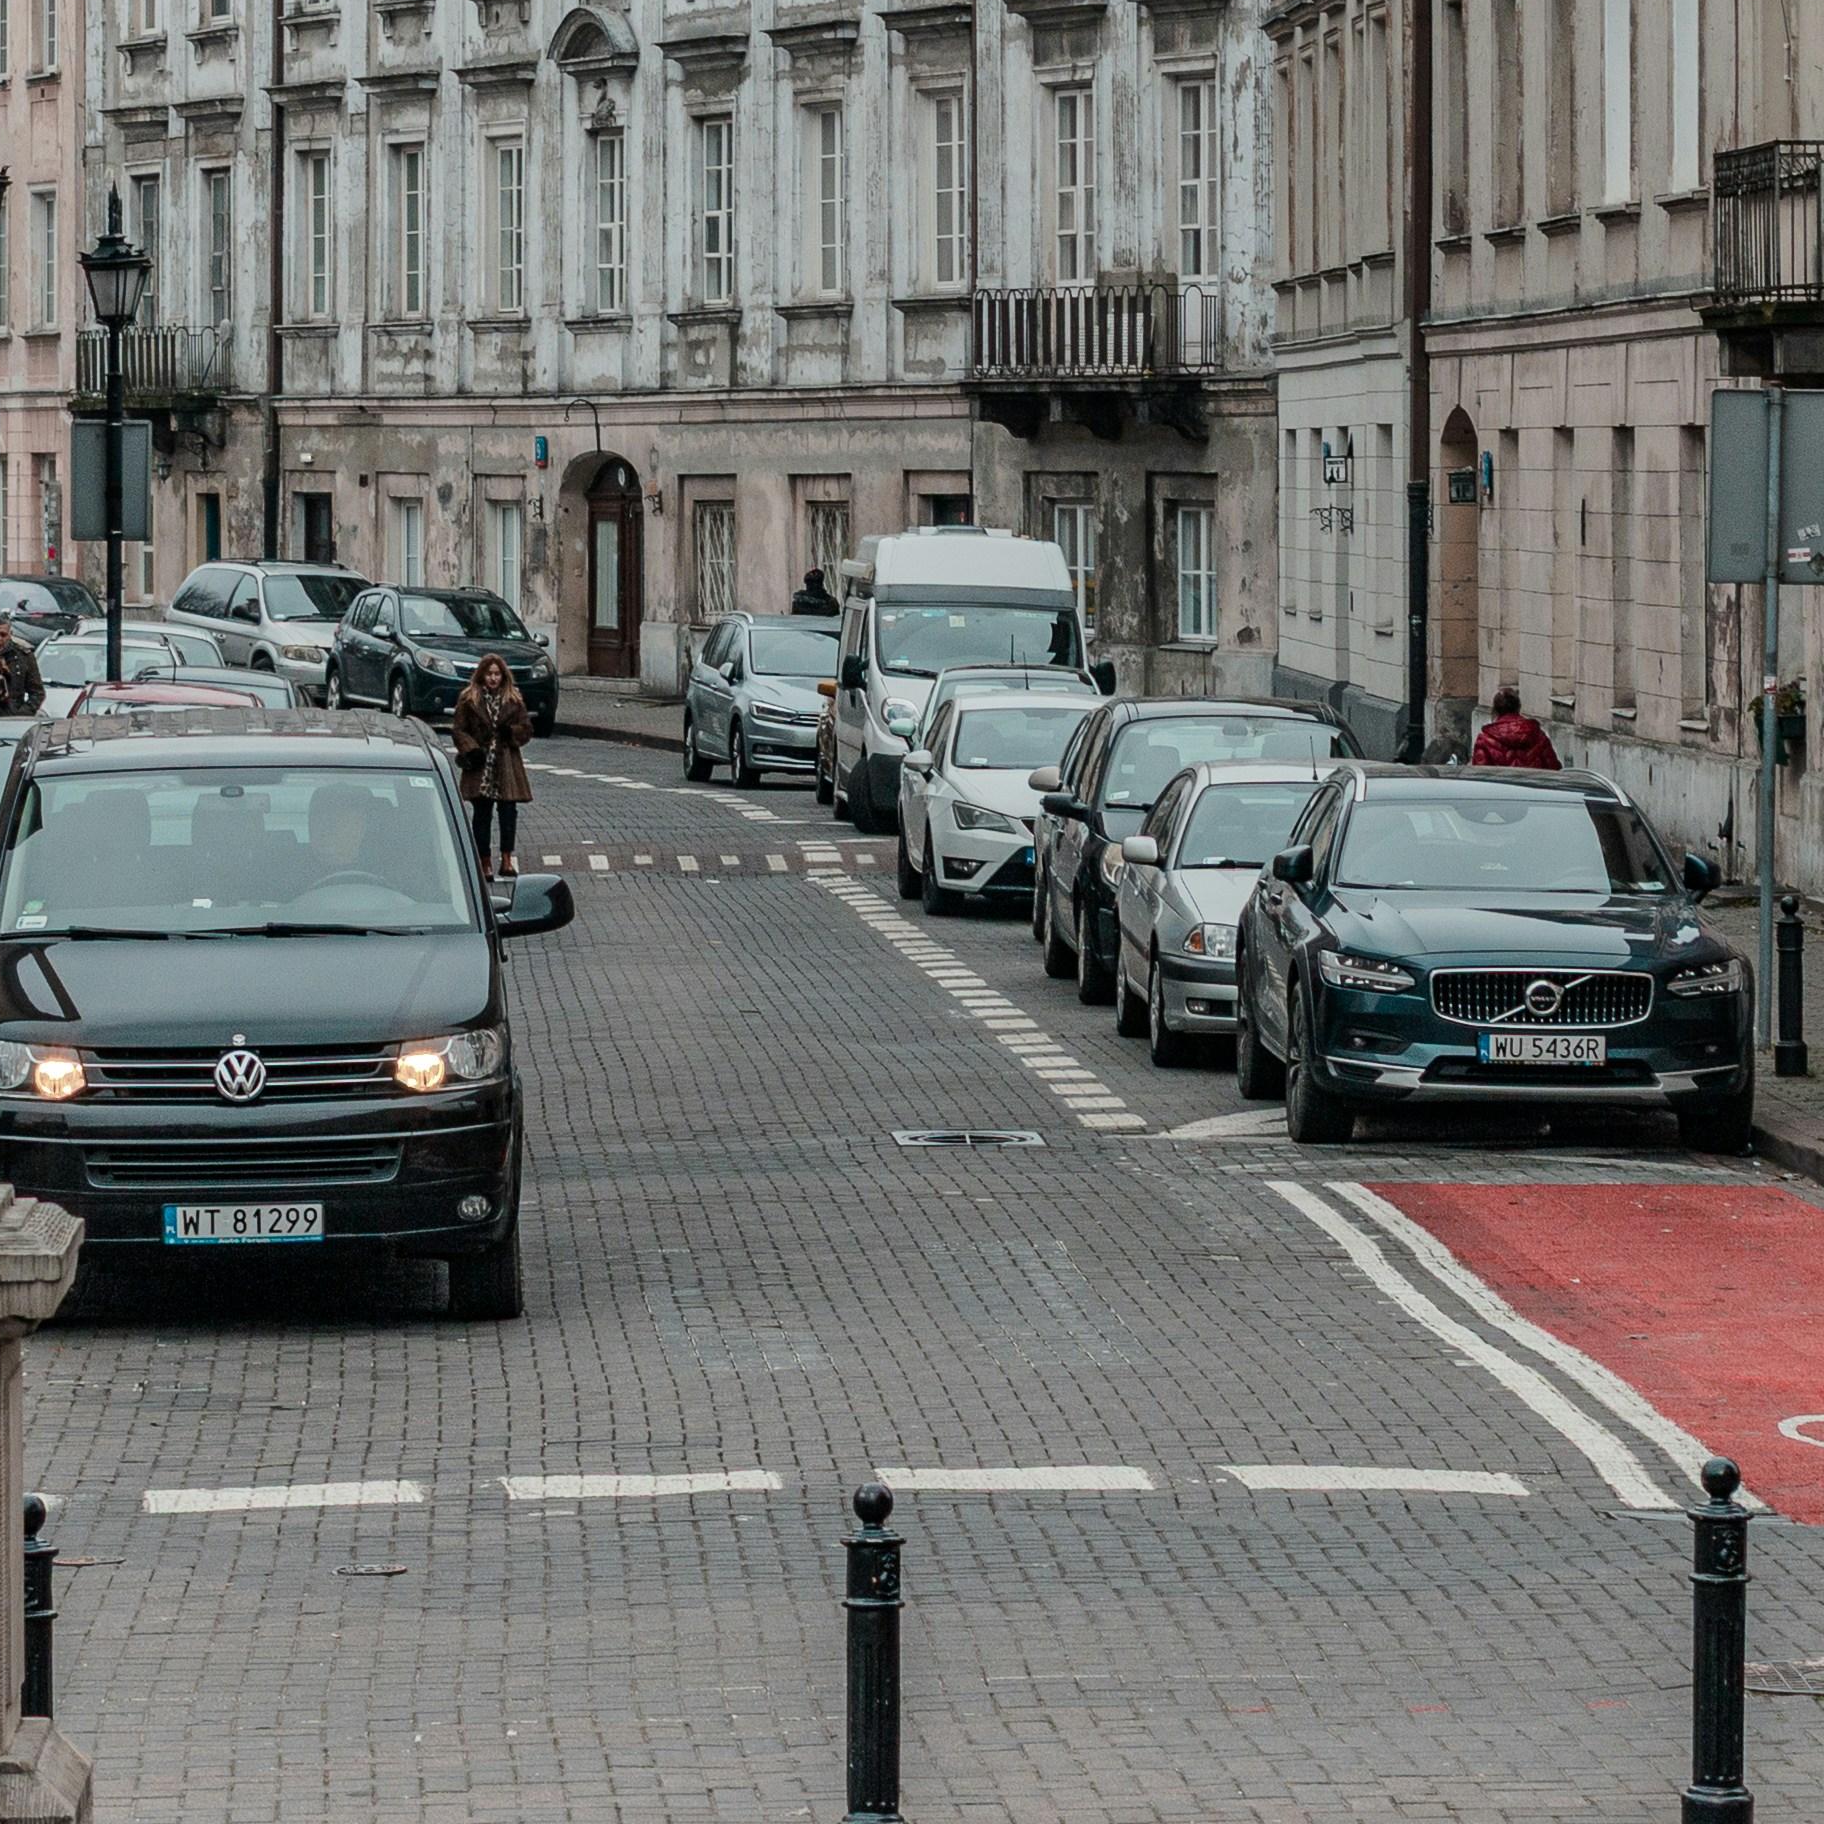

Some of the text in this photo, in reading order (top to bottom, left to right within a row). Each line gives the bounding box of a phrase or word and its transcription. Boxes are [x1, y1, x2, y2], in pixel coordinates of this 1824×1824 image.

[1495, 1037, 1523, 1059] WU
[1532, 1037, 1600, 1059] 5436R
[182, 1209, 221, 1236] WT
[233, 1207, 318, 1234] 81299
